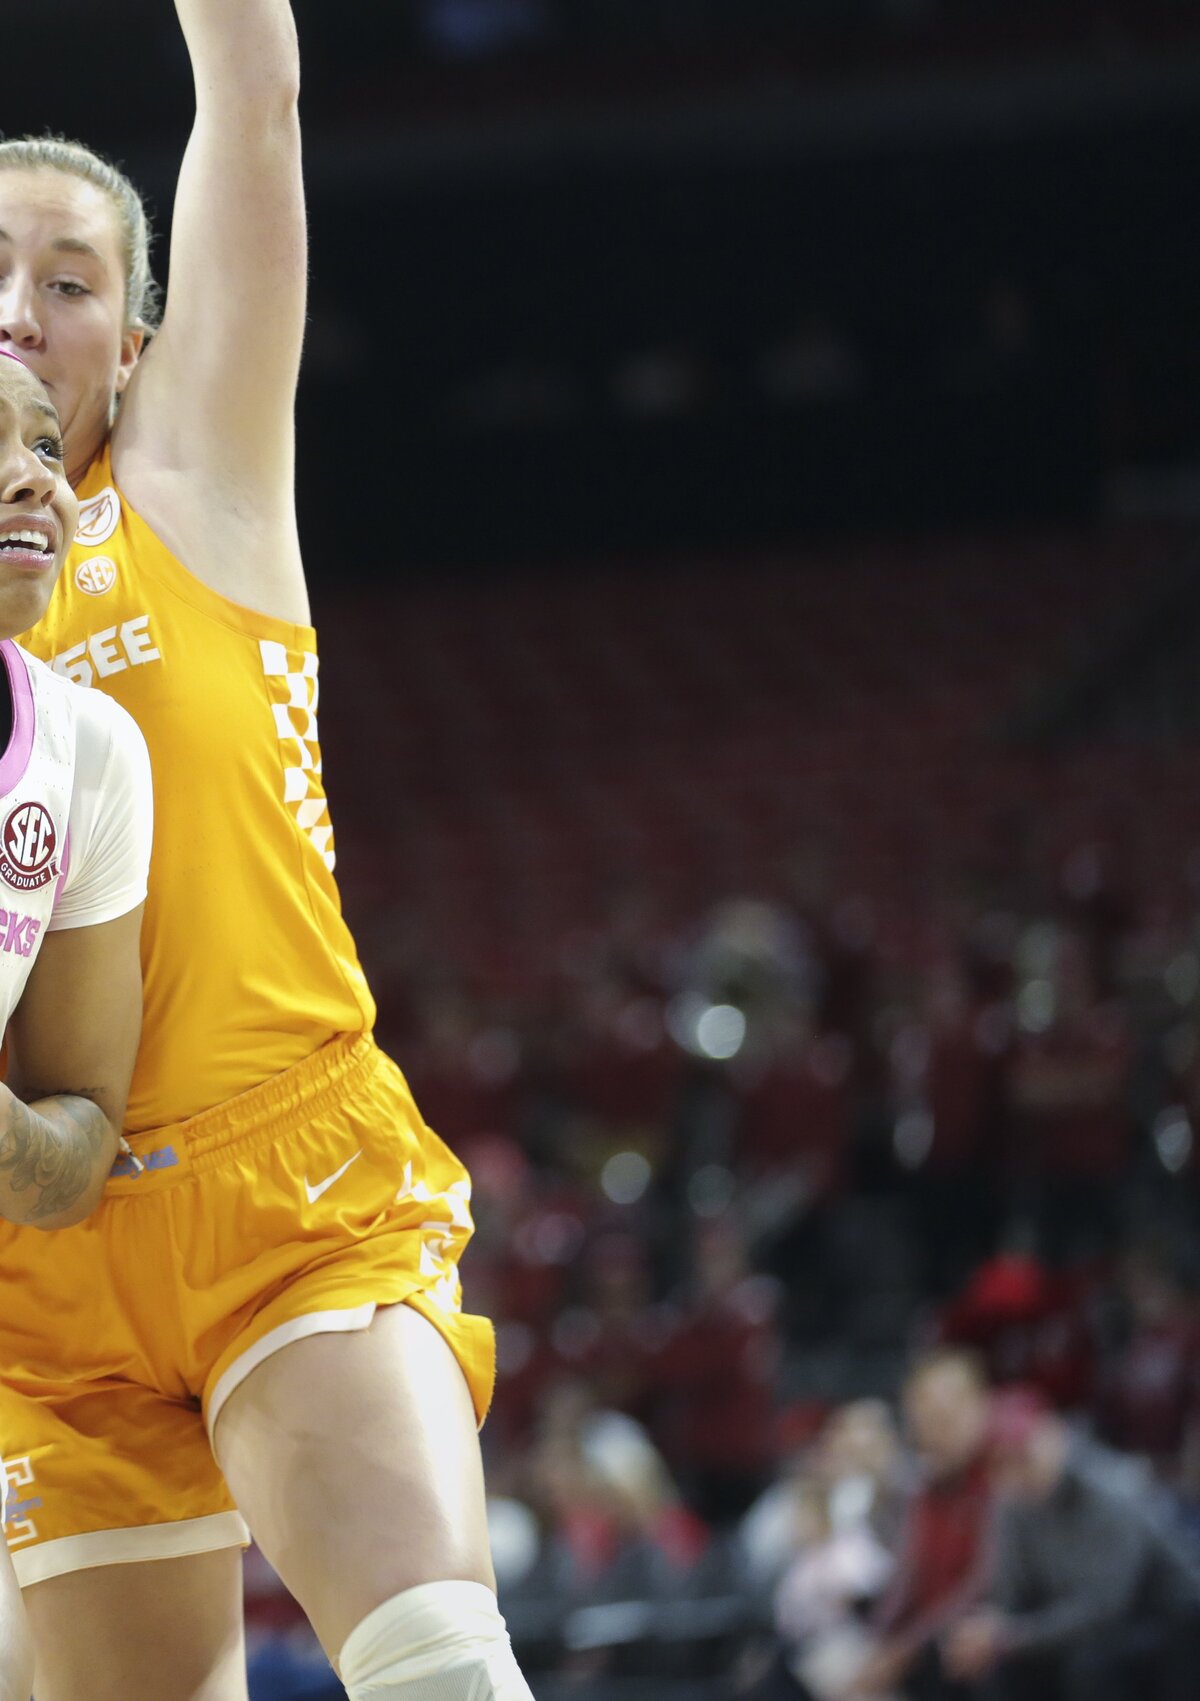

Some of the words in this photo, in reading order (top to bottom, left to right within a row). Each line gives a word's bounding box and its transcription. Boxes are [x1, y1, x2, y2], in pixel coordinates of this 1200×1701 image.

[77, 558, 116, 593] SEC
[45, 614, 161, 688] SEE
[8, 806, 53, 867] SEC
[0, 863, 46, 888] GRADUATE
